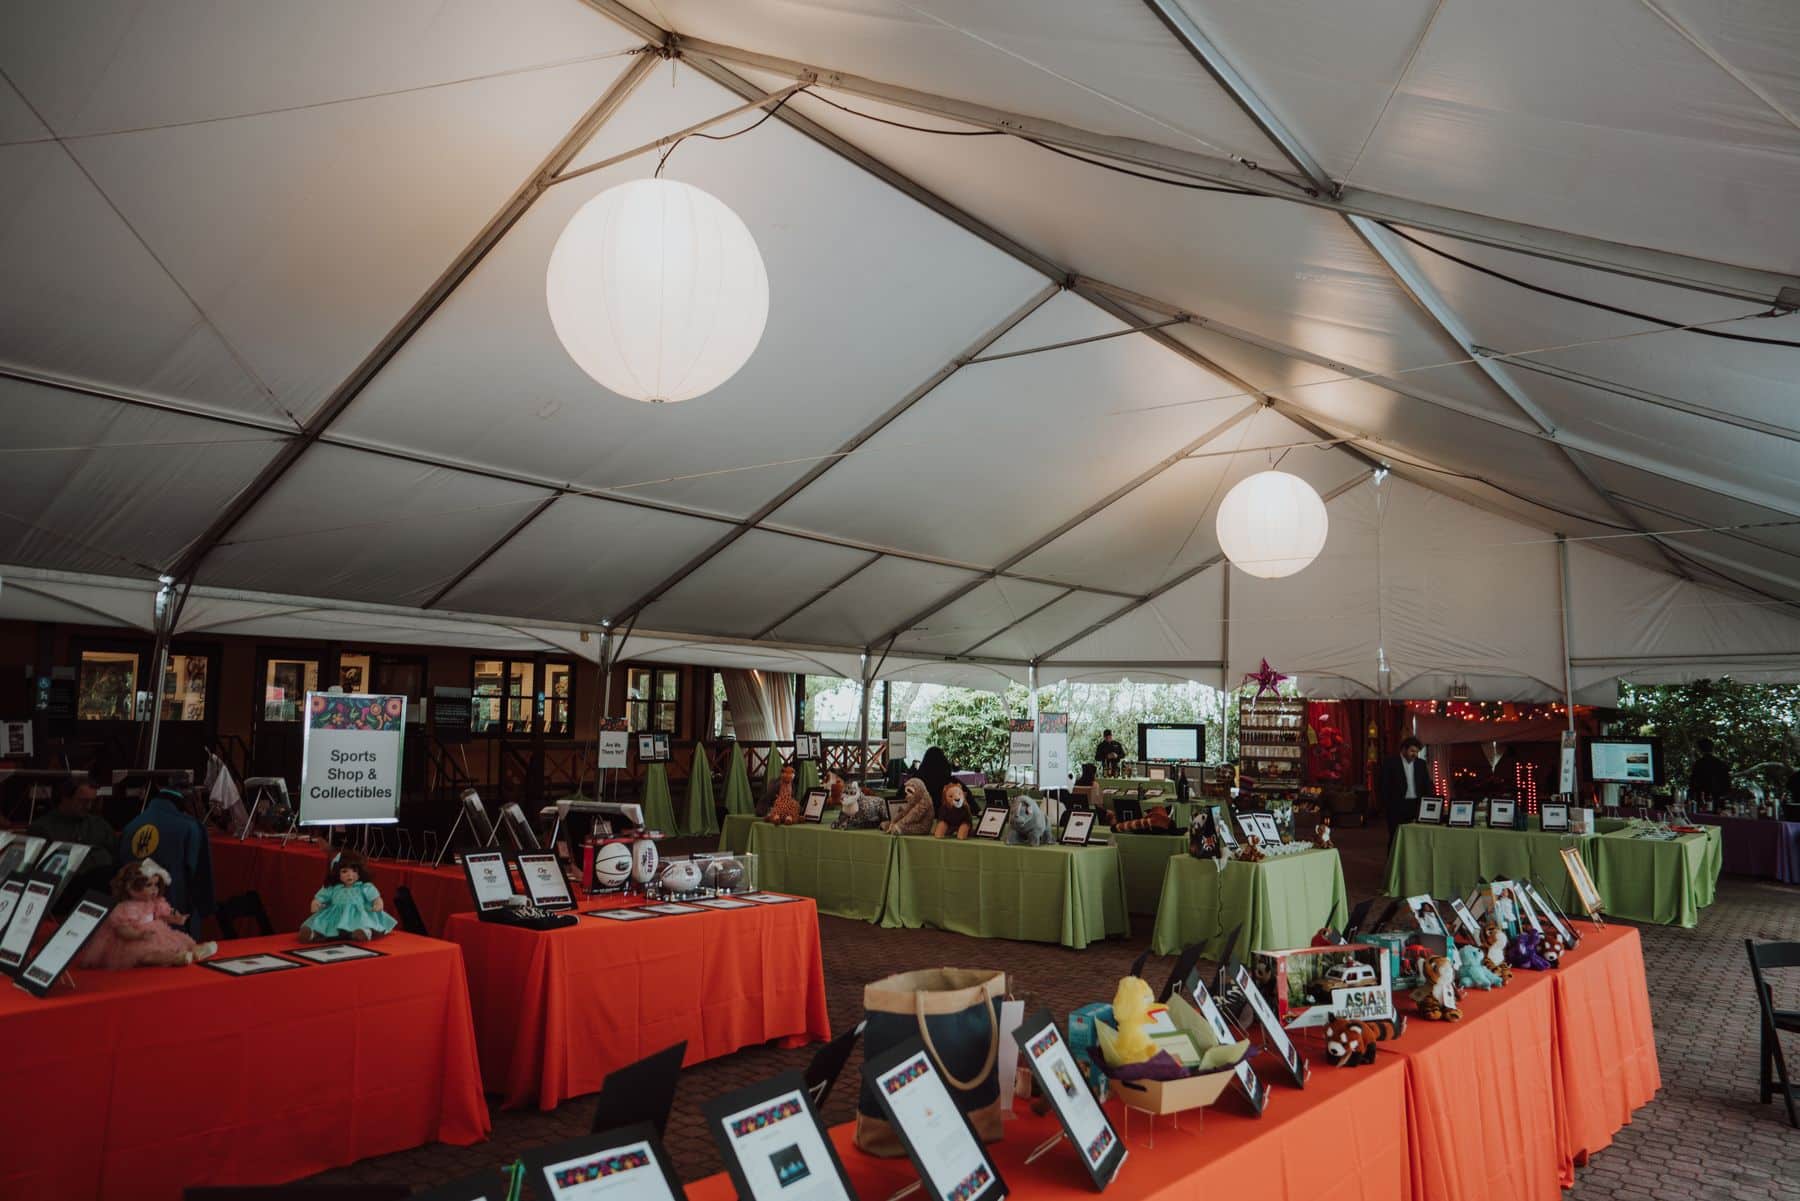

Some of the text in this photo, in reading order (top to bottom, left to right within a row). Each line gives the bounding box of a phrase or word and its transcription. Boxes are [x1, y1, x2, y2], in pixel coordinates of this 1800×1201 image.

[330, 749, 377, 764] Sports
[327, 767, 377, 782] Shop &
[310, 786, 392, 799] Collectibles
[1345, 991, 1387, 1008] ASIAN
